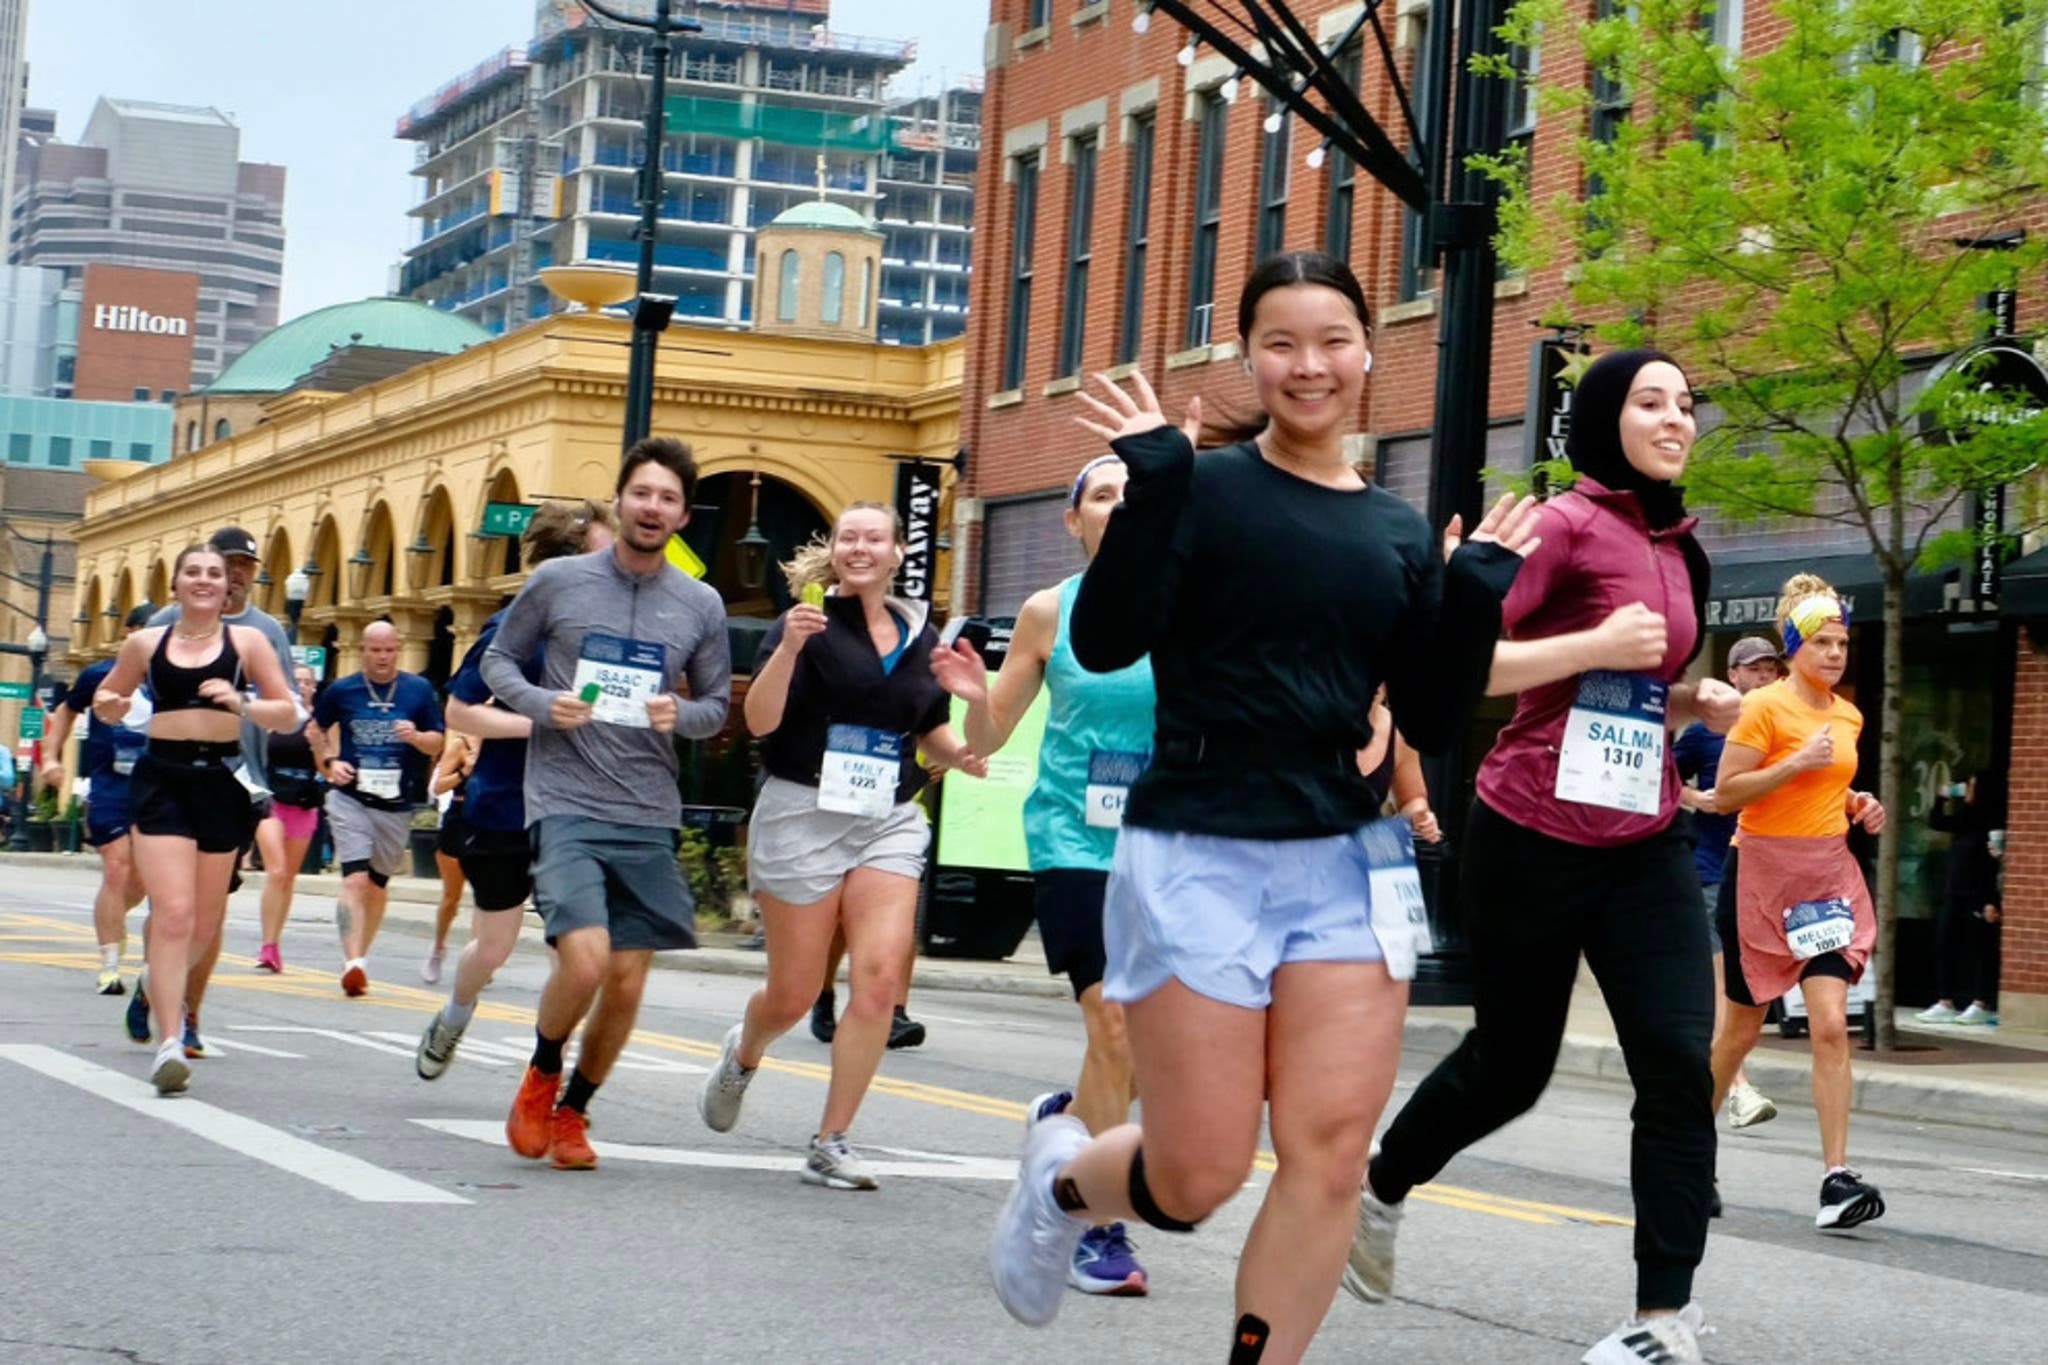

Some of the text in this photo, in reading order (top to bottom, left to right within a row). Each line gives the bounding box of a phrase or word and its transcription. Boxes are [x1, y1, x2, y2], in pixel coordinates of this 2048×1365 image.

[94, 303, 188, 336] Hilton
[596, 669, 641, 687] ISAAC
[1588, 721, 1653, 750] SALMA
[843, 760, 884, 776] EMILY
[1603, 746, 1644, 771] 1310
